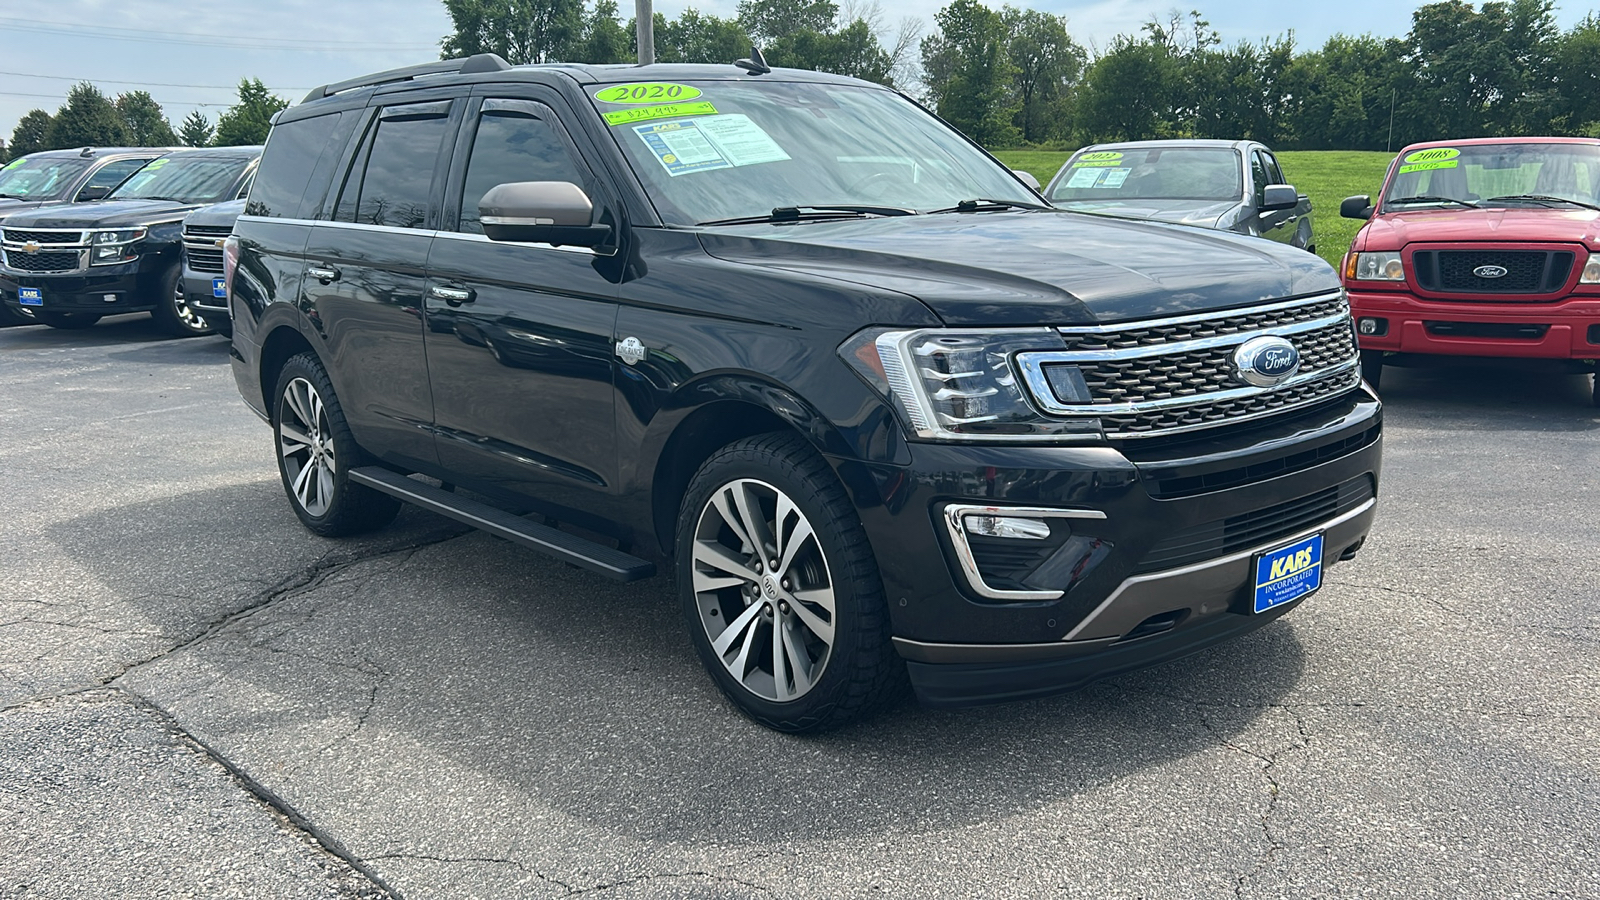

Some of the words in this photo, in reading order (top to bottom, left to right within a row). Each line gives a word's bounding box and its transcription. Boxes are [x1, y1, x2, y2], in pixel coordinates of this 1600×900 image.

[613, 85, 682, 101] 2020
[652, 122, 681, 132] KARS
[1412, 150, 1451, 162] 2008
[1480, 267, 1500, 276] Ford
[22, 290, 38, 298] KARS
[1265, 349, 1292, 370] Ford
[1269, 546, 1312, 580] KARS
[1265, 568, 1313, 594] INCORPORATED
